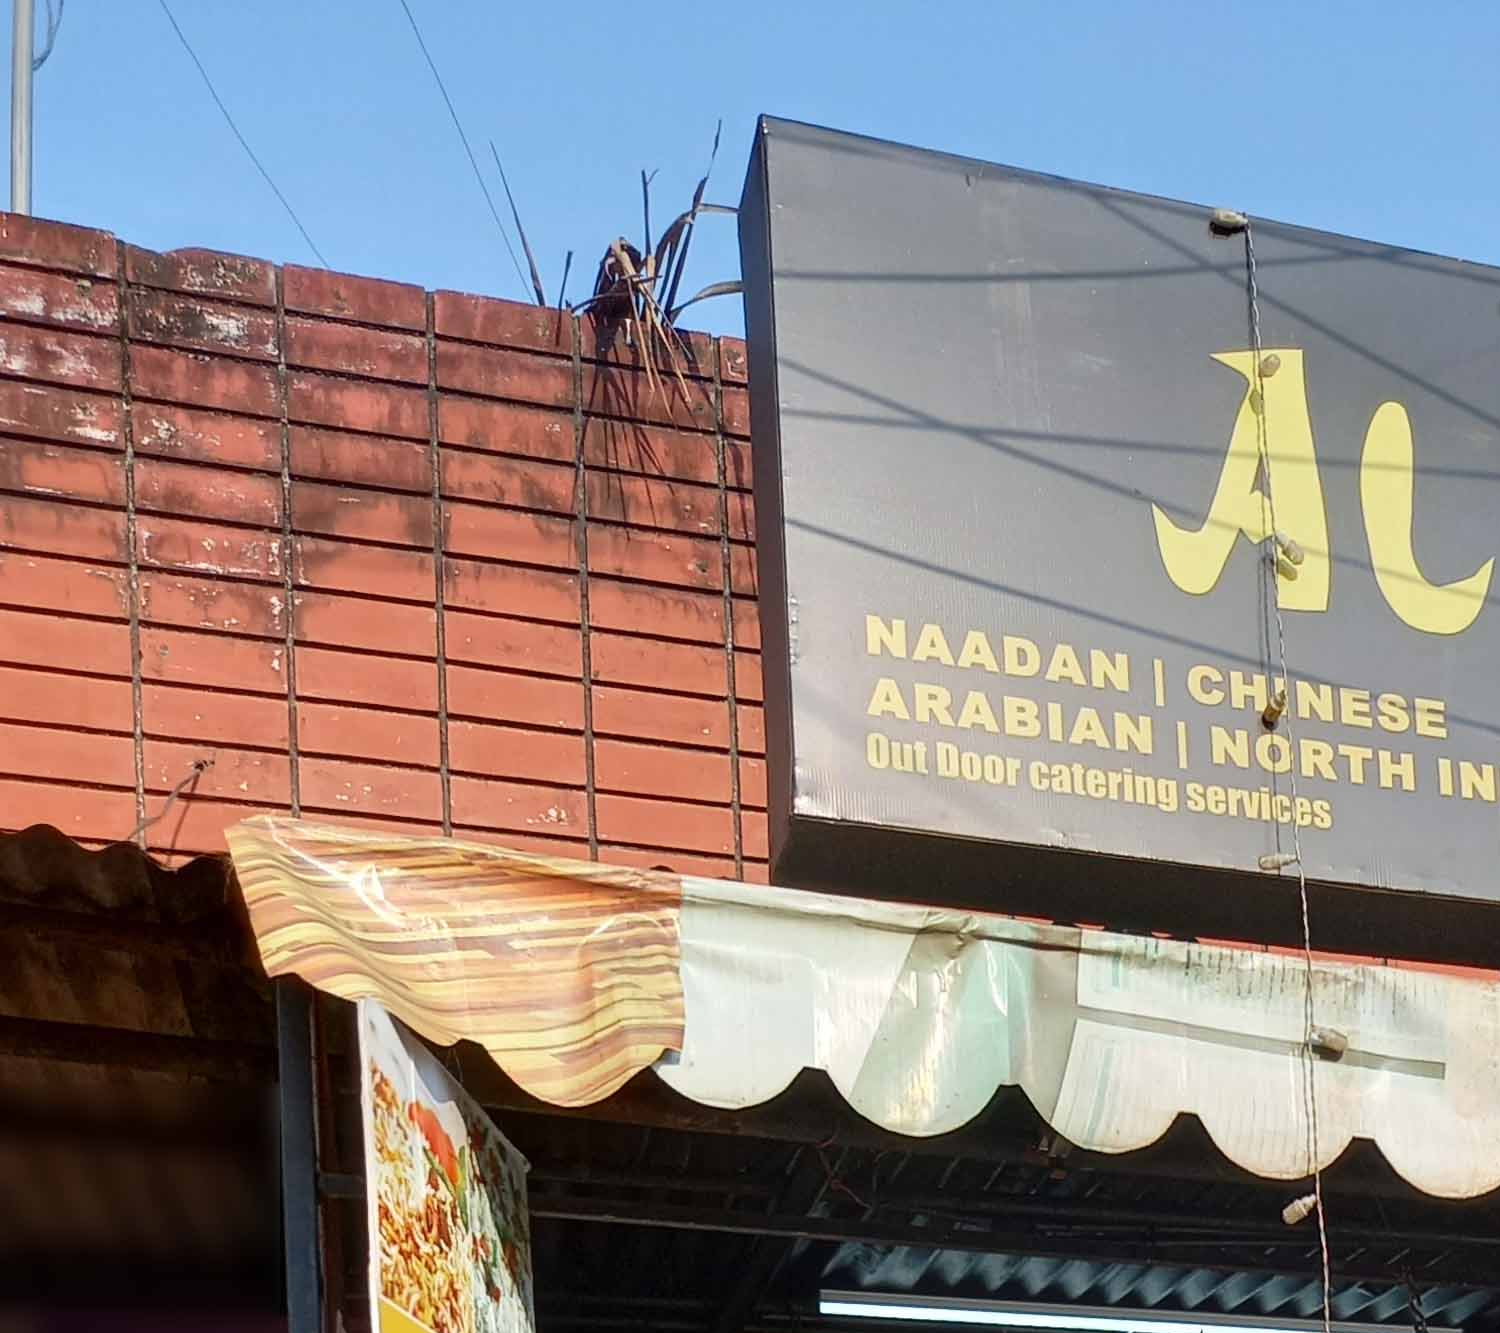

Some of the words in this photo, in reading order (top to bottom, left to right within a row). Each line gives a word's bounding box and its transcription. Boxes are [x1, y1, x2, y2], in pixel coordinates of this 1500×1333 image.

[865, 614, 1129, 692] NAADAN
[1187, 664, 1448, 739] CHINESE
[866, 677, 1153, 754] ARABIAN
[1211, 725, 1416, 791] NORTH
[866, 732, 928, 774] Out
[935, 741, 1023, 787] Door
[1029, 761, 1178, 813] catering
[1186, 781, 1333, 829] services
